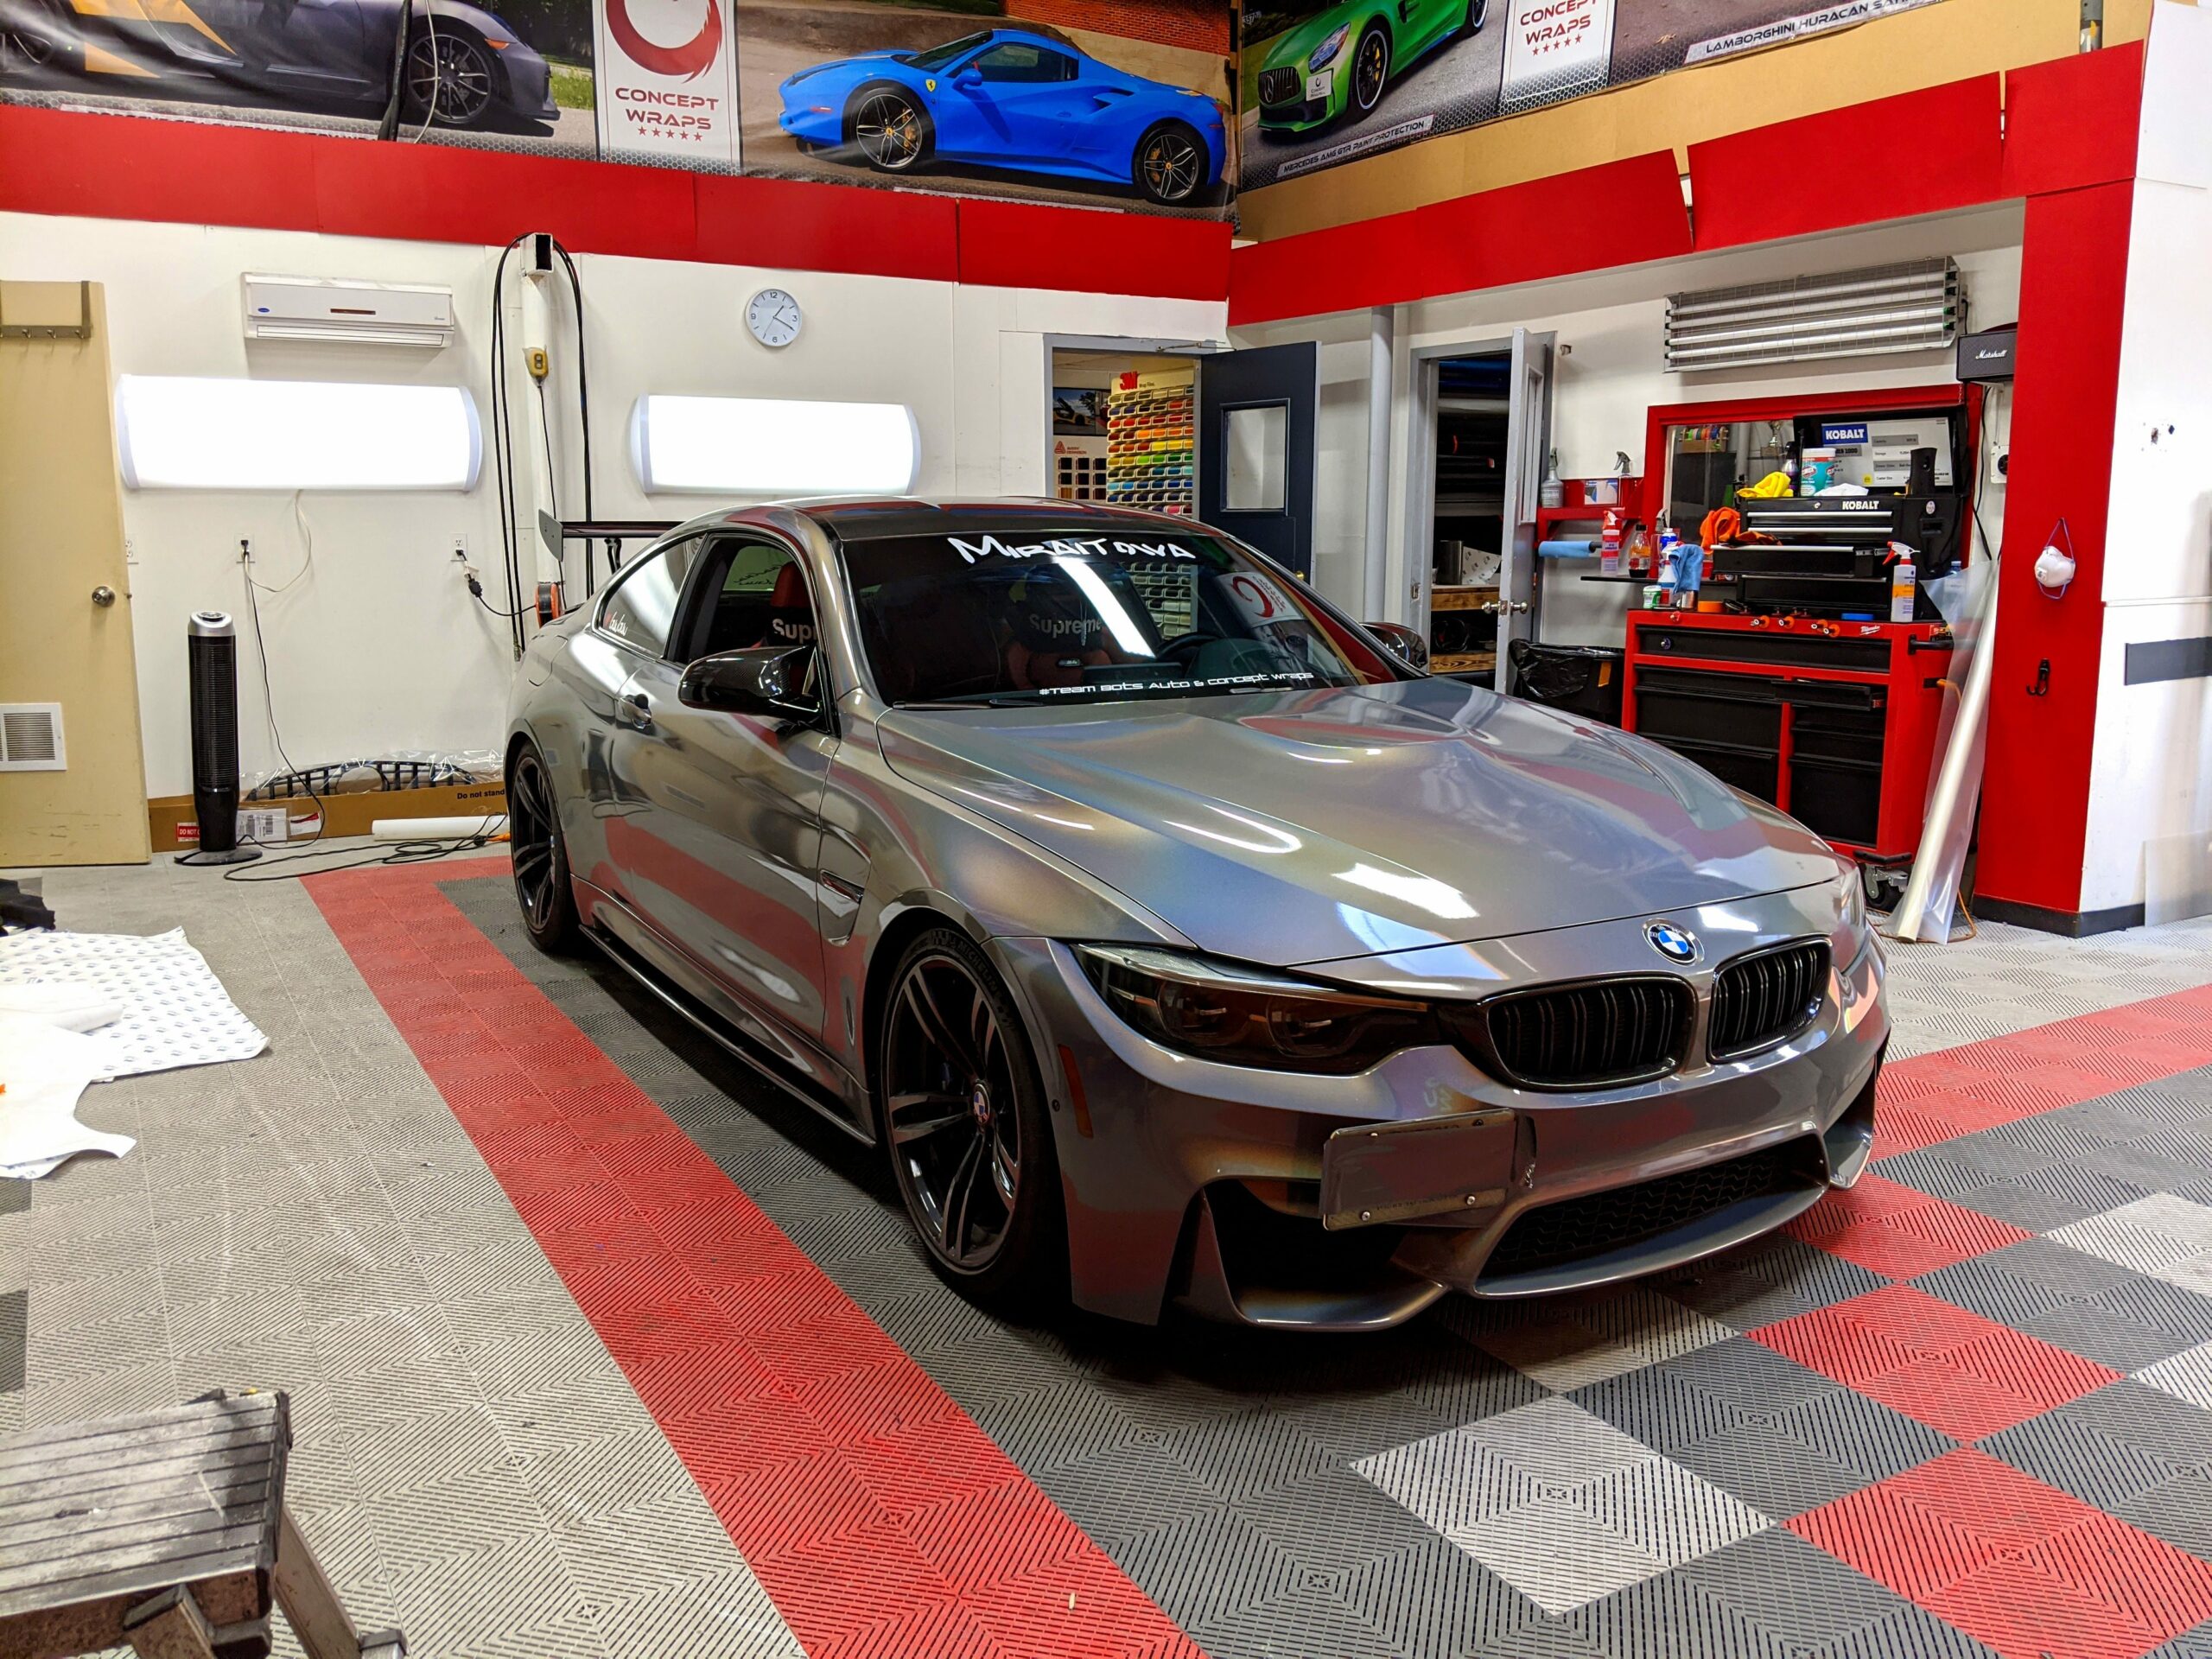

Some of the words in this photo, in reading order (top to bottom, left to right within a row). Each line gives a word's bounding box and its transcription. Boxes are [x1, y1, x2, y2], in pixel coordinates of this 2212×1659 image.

[1525, 14, 1592, 46] WRAPS
[1706, 22, 1796, 54] LAMBORGHINI
[1798, 1, 1868, 30] HURACAN
[614, 87, 720, 111] CONCEPT
[625, 108, 712, 130] WRAPS
[1283, 155, 1319, 173] MERCEDES
[1320, 148, 1337, 162] AMG
[1338, 144, 1351, 156] GTR
[1353, 137, 1374, 150] PAINT
[1375, 120, 1425, 143] PROTECTION
[1119, 371, 1139, 391] 3M
[1825, 428, 1865, 441] KOBALT
[1841, 500, 1879, 511] KOBALT
[1148, 679, 1191, 690] Auto
[484, 788, 505, 797] stand
